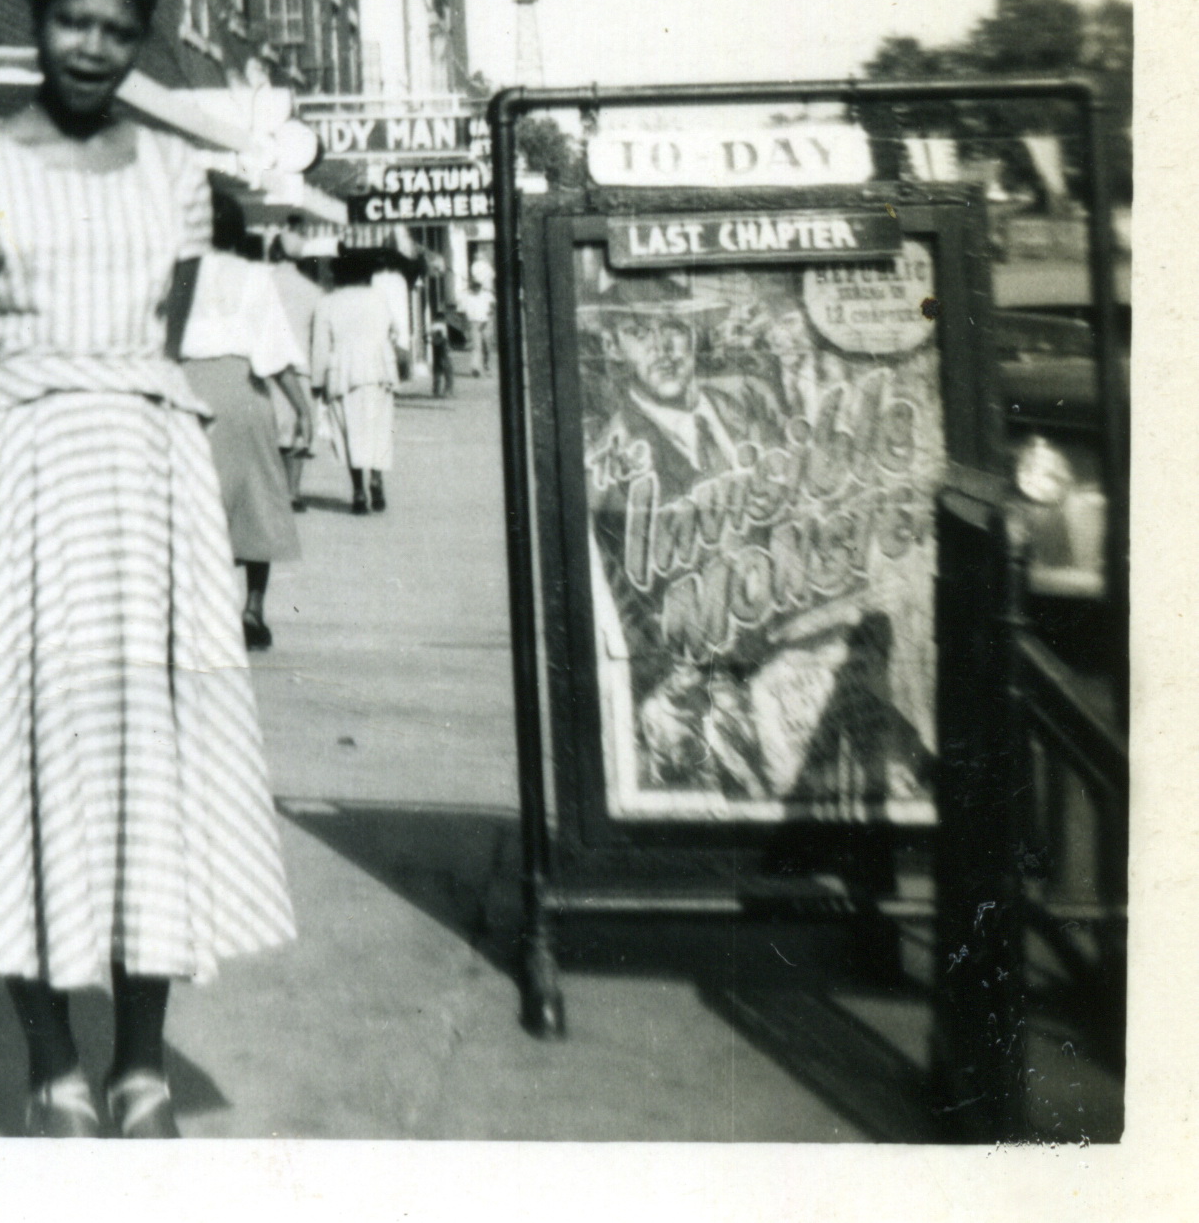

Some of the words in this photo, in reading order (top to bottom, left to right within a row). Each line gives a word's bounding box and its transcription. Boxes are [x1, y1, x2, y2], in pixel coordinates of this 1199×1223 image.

[387, 118, 456, 150] MAN
[385, 167, 480, 193] STATUM
[627, 222, 709, 256] LAST
[717, 217, 859, 252] CHAPTER
